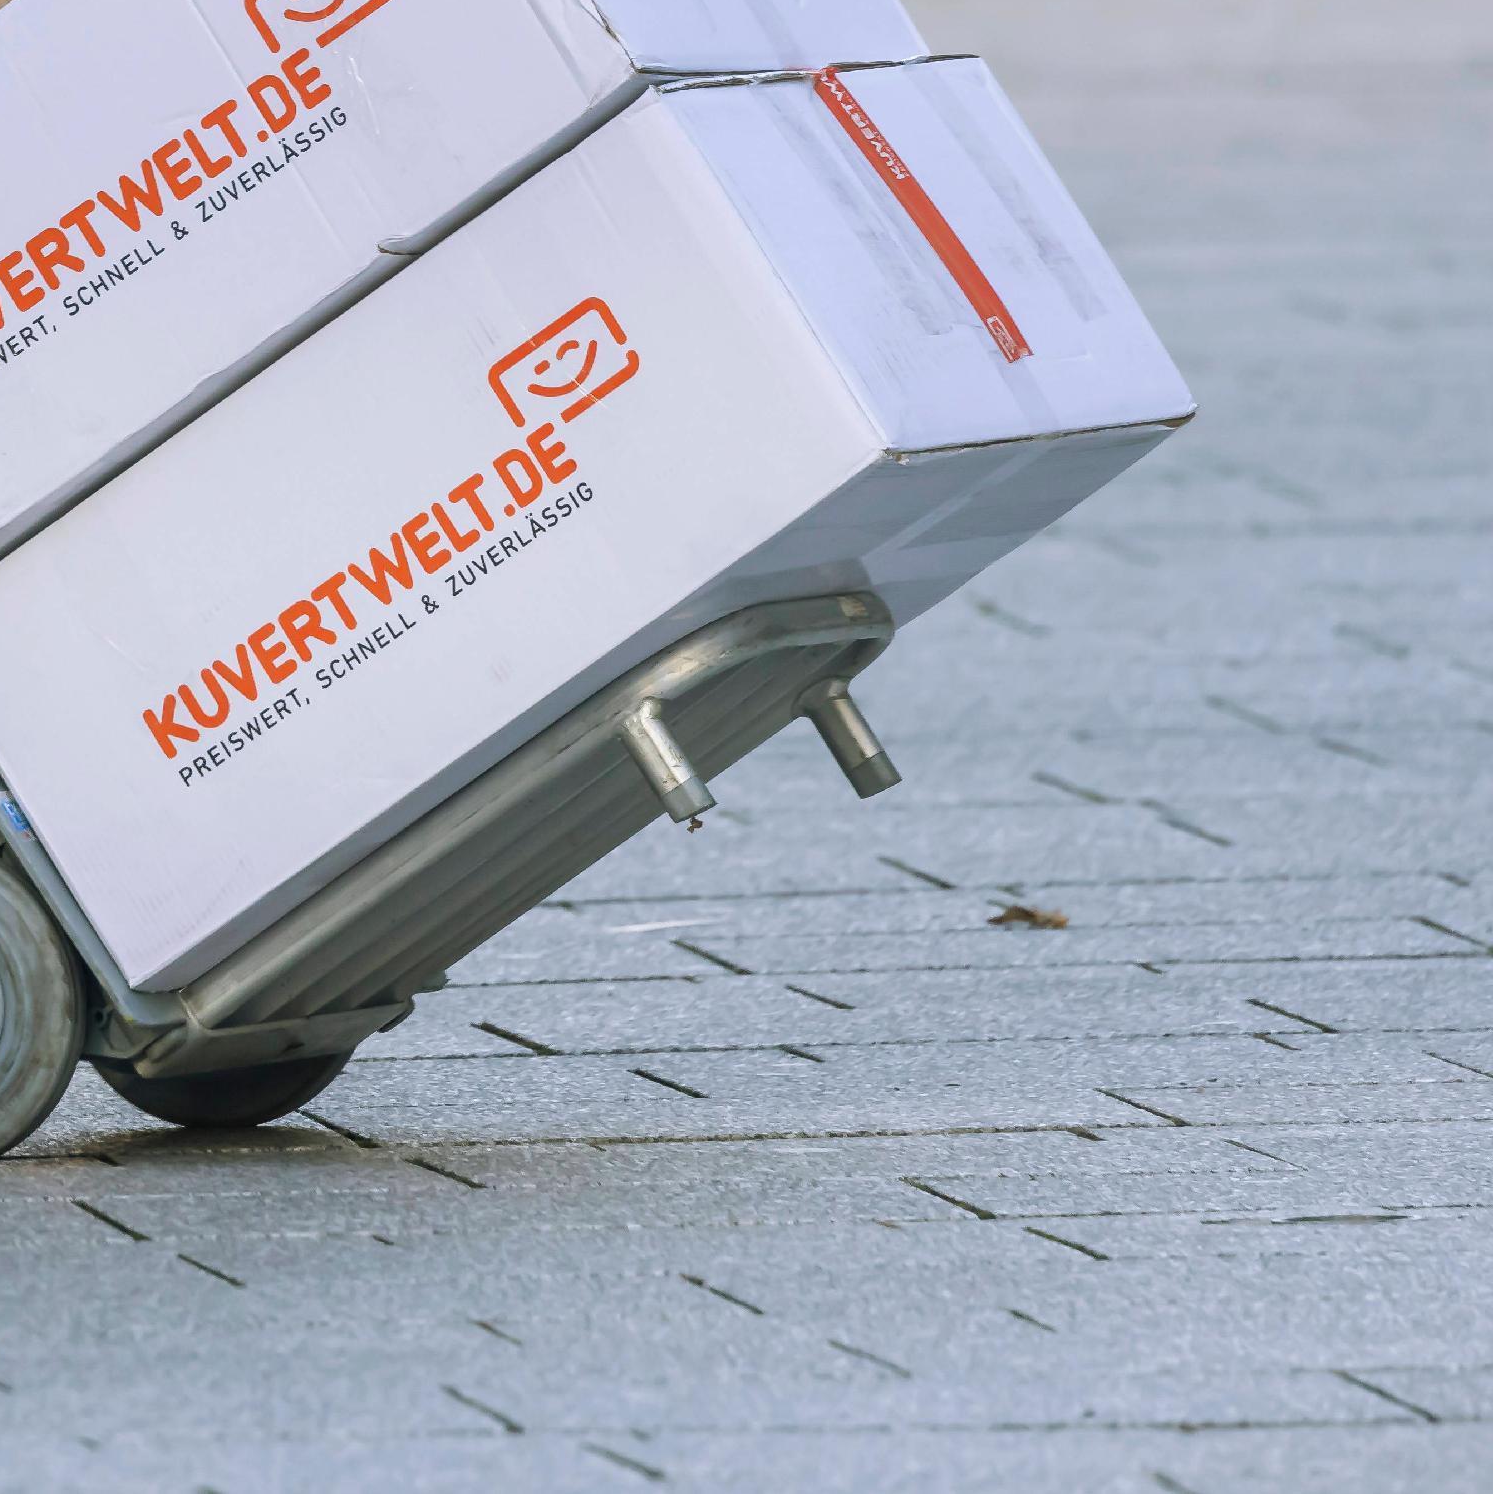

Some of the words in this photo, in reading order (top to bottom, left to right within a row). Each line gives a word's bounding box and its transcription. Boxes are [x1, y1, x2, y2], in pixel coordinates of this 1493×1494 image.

[62, 239, 166, 316] SCHNELL
[170, 220, 189, 241] &
[195, 106, 350, 223] ZUVERLÄSSIG
[143, 422, 577, 759] KUVERTWELT.DE
[177, 688, 312, 788] PREISWERT,
[315, 613, 417, 689] SCHNELL
[421, 594, 440, 615] &
[444, 482, 594, 597] ZUVERLÄSSIG
